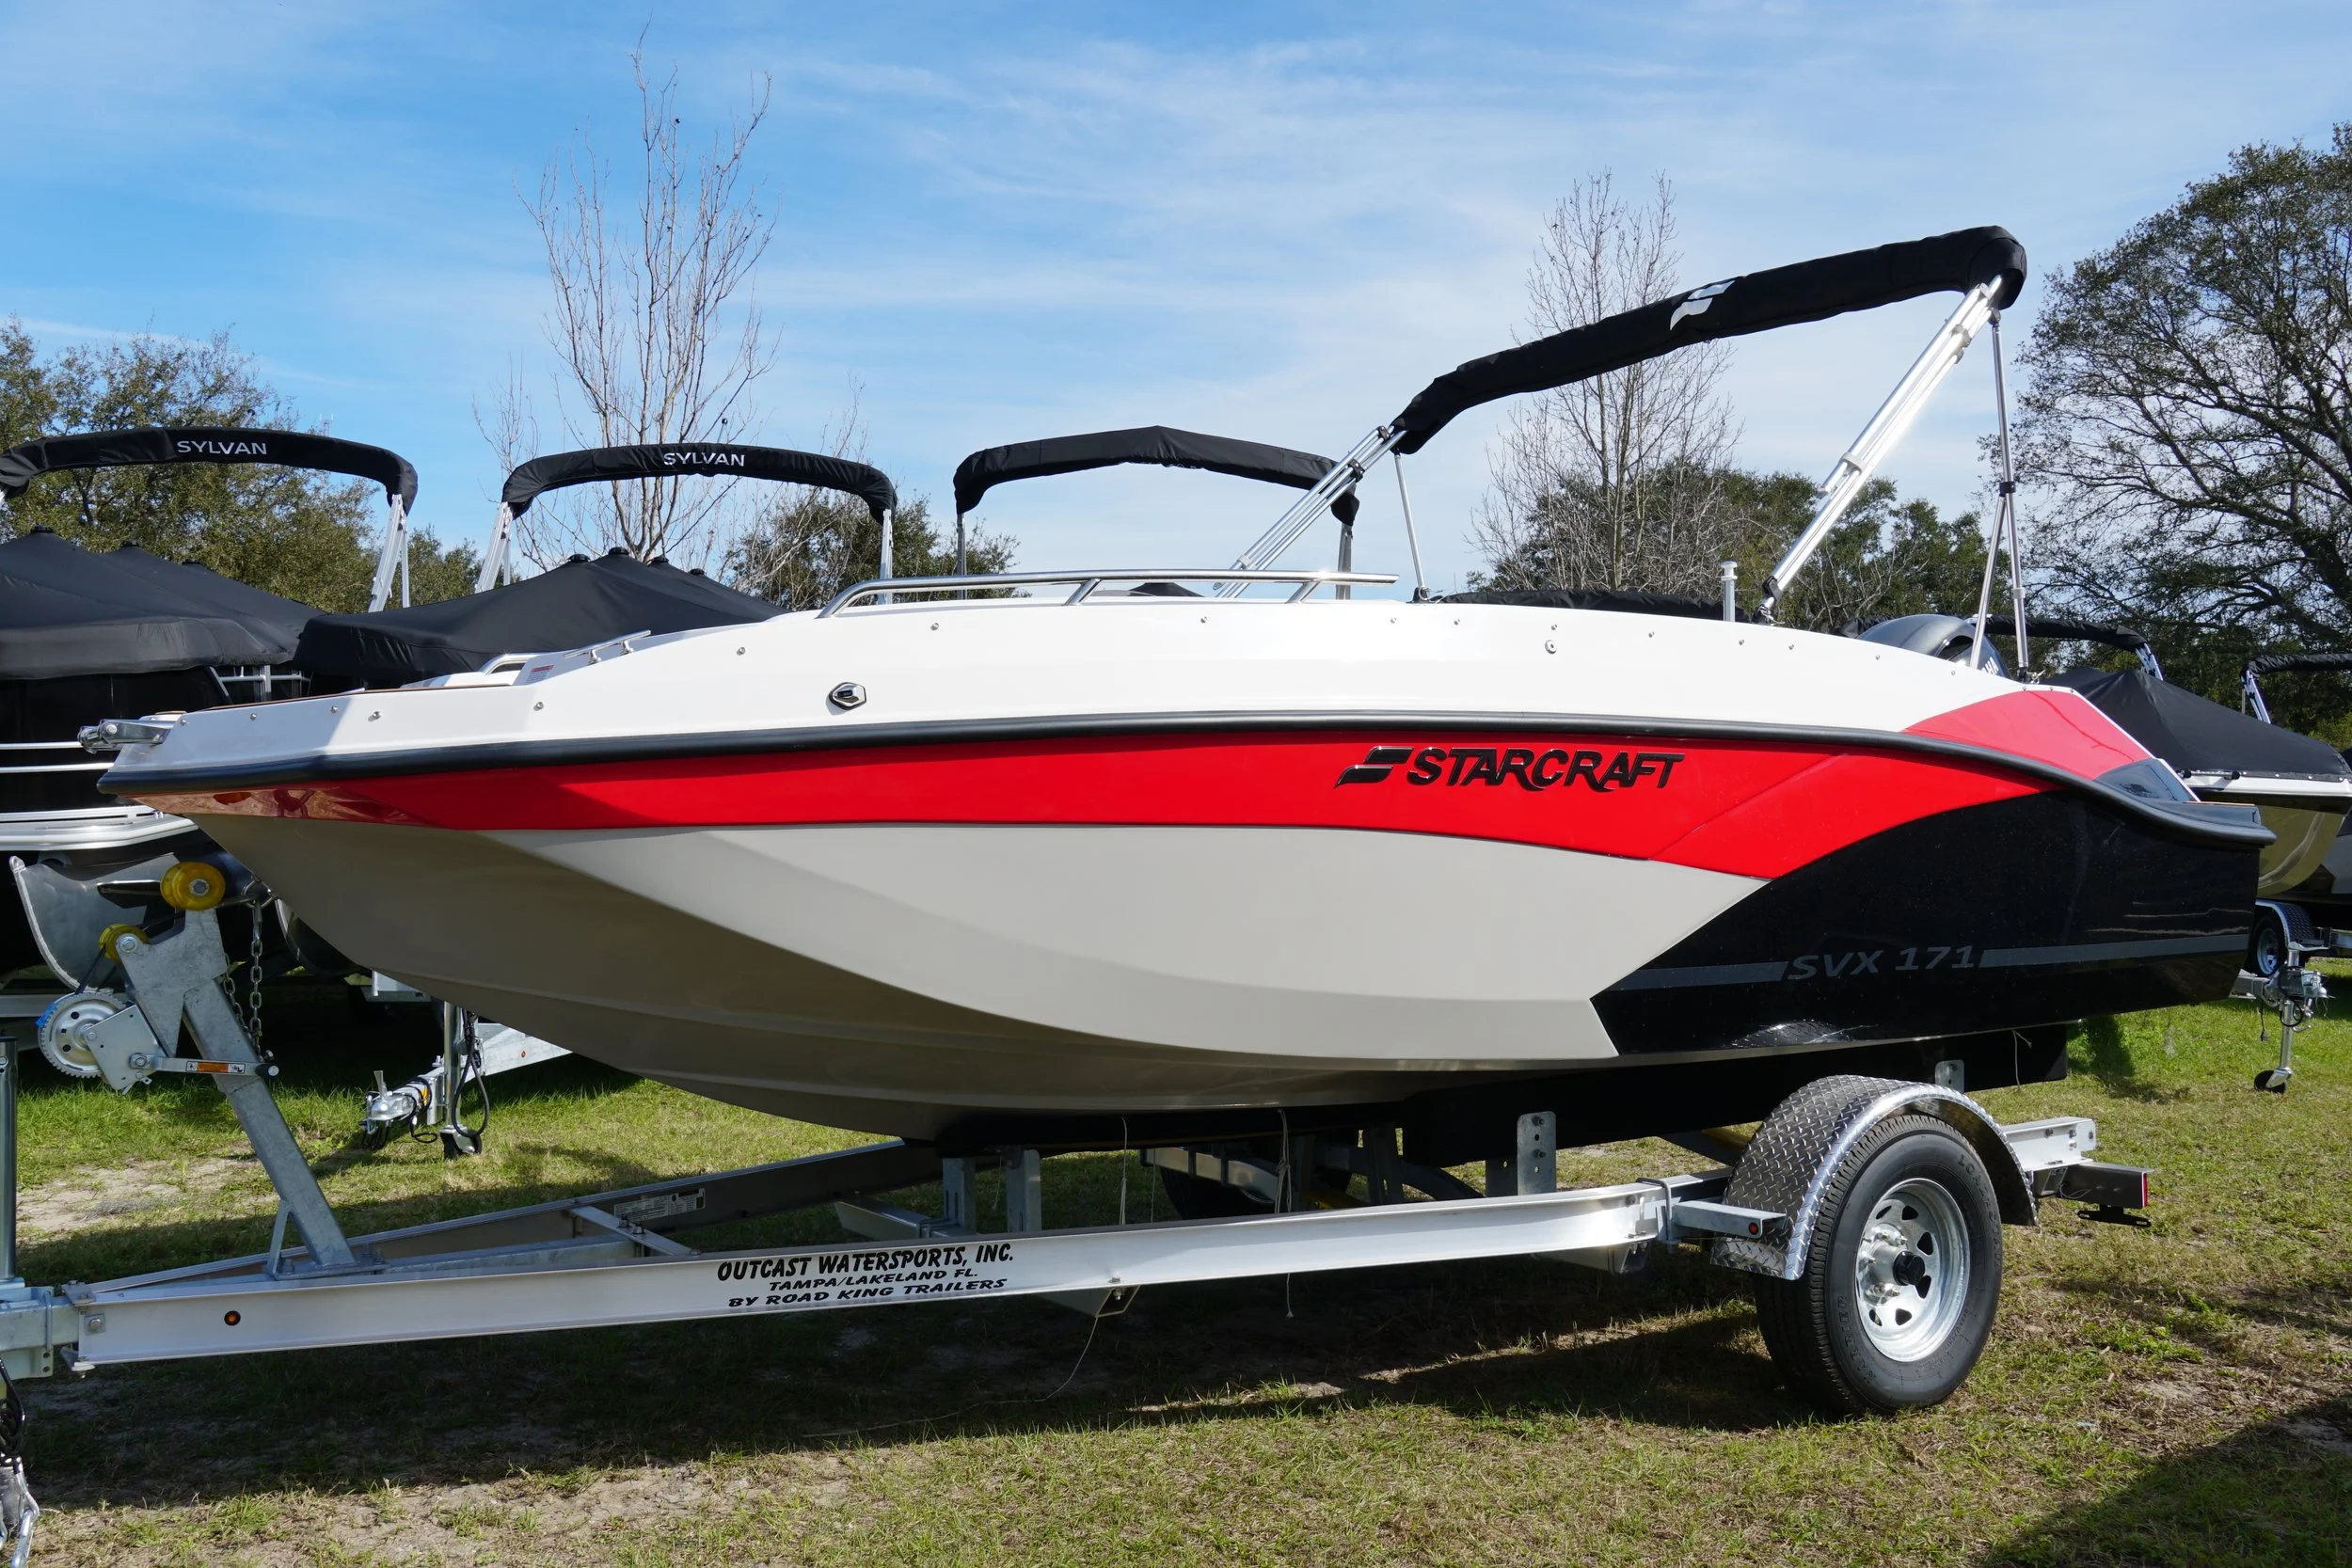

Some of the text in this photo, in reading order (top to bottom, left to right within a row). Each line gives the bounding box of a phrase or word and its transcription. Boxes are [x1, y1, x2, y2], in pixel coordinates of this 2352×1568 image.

[177, 440, 267, 455] SYLVAN
[663, 451, 745, 467] SYLVAN
[1408, 746, 1686, 792] STARCRAFT
[1788, 945, 1974, 980] SVX 171
[717, 1243, 1013, 1281] OUTCAST WATERSPORTS, INC.
[728, 1278, 1008, 1307] BY ROAD KING TRAILERS
[769, 1268, 978, 1291] TAMPA/LAKELAND FL.
